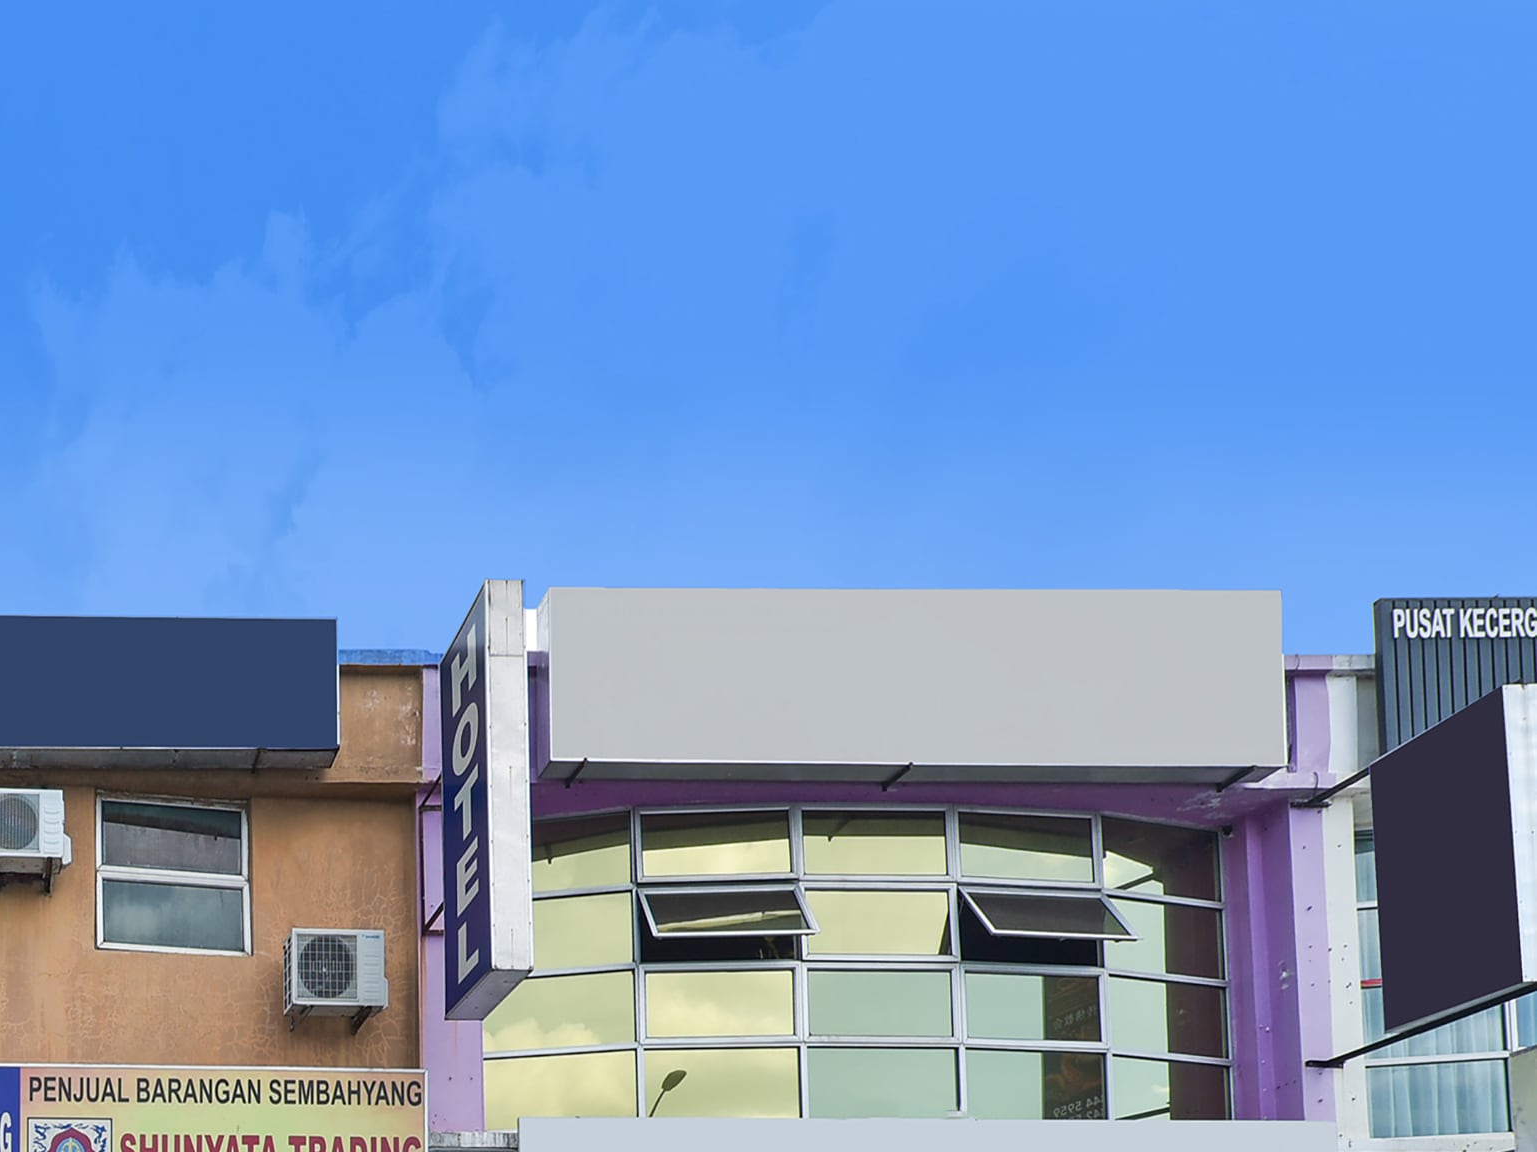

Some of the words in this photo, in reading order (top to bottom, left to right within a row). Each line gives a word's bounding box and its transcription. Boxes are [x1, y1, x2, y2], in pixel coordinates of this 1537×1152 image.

[1393, 608, 1455, 639] PUSAT
[1459, 608, 1537, 639] KECERG
[451, 623, 480, 985] HOTEL
[29, 1076, 129, 1103] PENJUAL
[136, 1078, 261, 1105] BARANGAN
[268, 1079, 423, 1107] SEMBAHYANG
